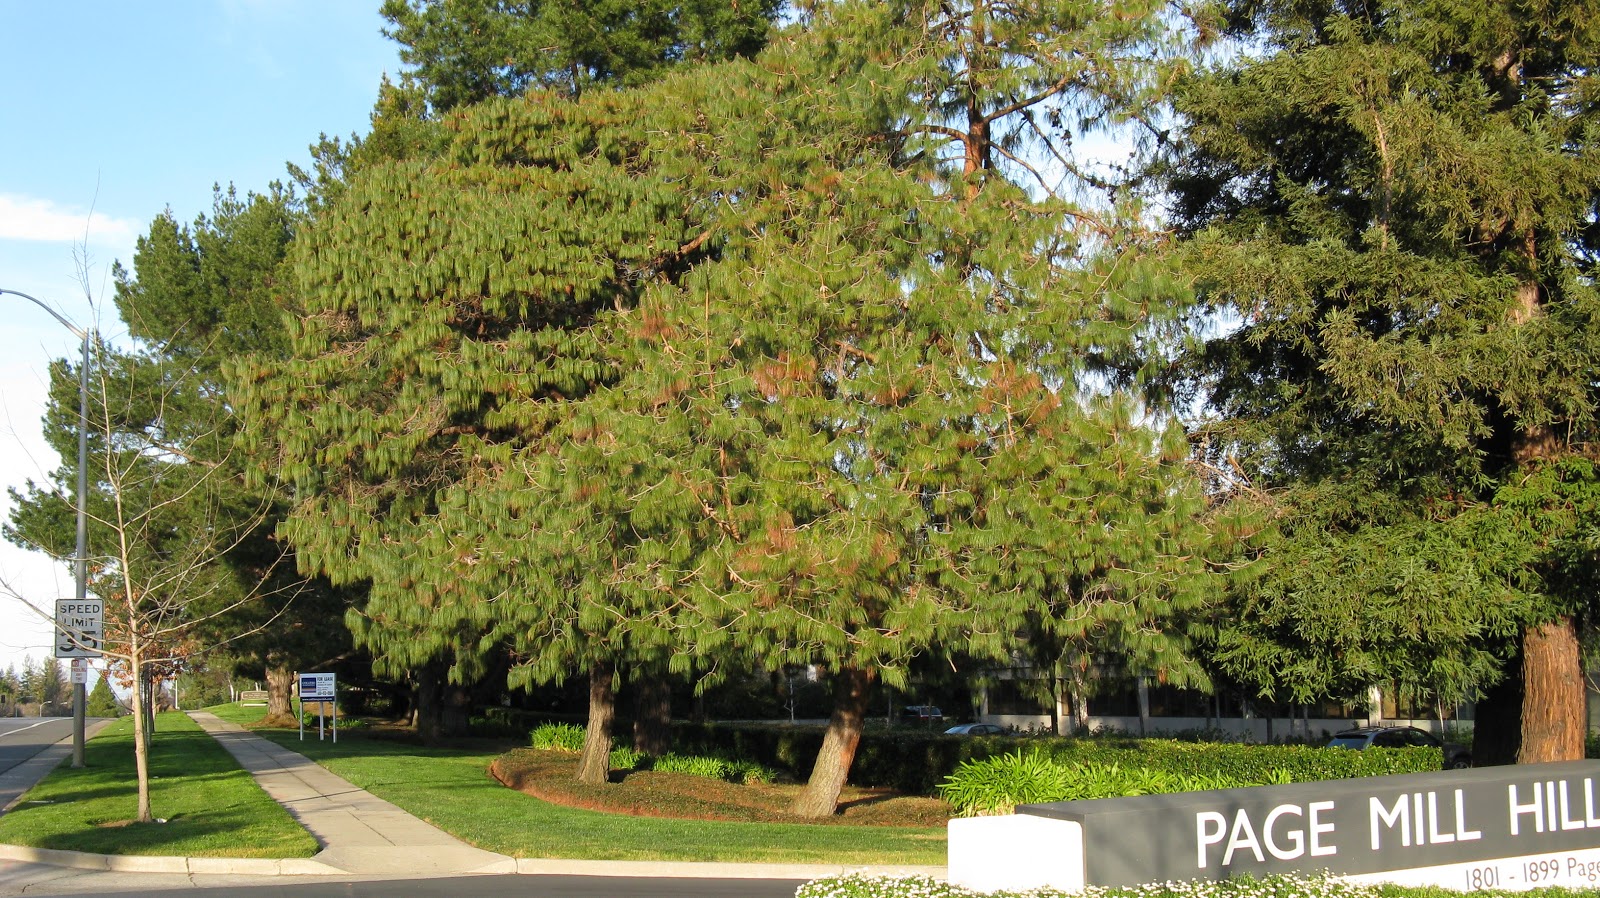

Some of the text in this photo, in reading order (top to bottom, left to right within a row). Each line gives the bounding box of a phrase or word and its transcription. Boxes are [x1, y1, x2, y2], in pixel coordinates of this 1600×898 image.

[60, 604, 100, 614] SPEED
[63, 617, 95, 627] LIMIT
[60, 630, 98, 652] 35
[1196, 800, 1337, 868] PAGE
[1369, 789, 1482, 850] MILL
[1466, 866, 1500, 890] 1801
[1523, 859, 1559, 883] 1899
